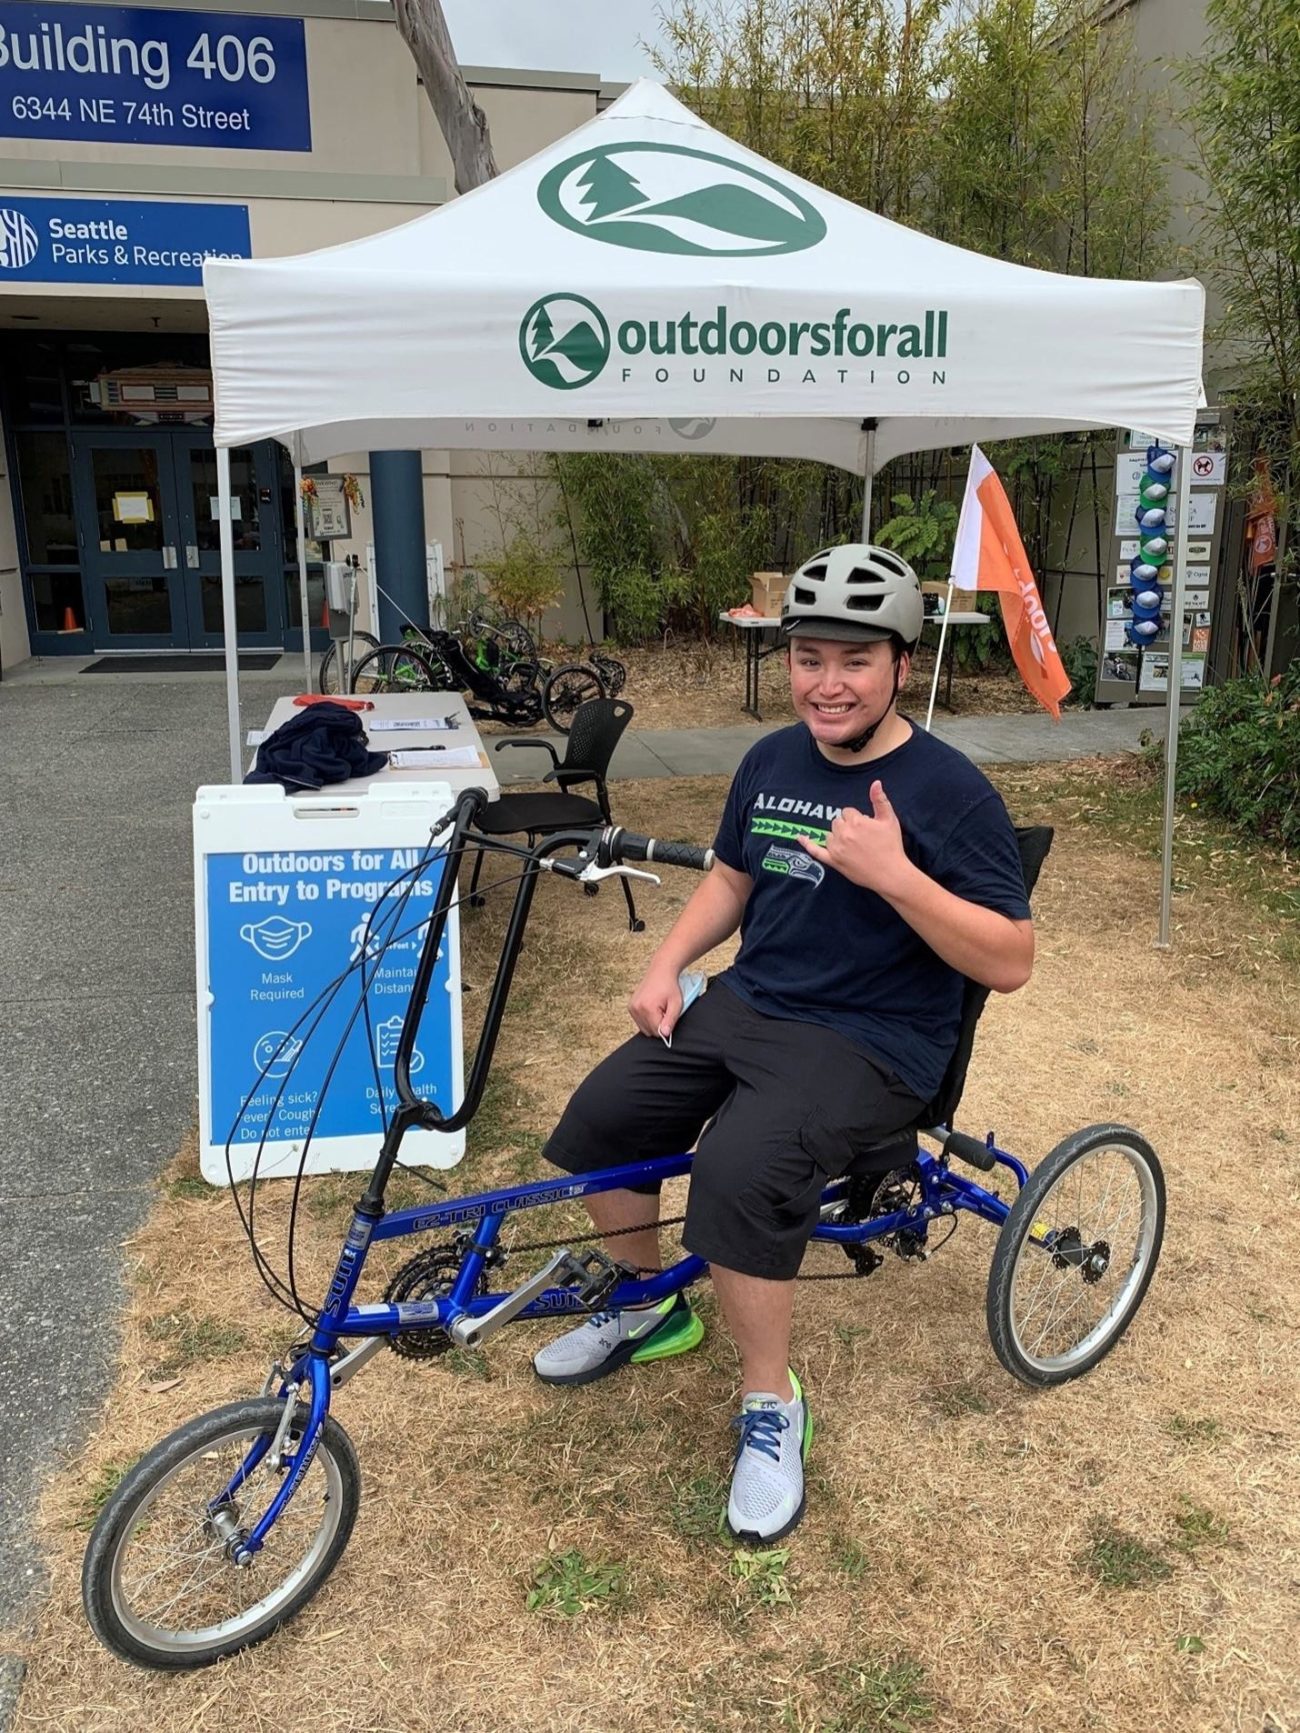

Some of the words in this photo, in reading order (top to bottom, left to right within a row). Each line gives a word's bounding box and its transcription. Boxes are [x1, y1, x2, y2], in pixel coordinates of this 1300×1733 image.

[186, 32, 277, 84] 406
[12, 95, 72, 121] 6344
[79, 98, 116, 124] NE
[122, 101, 174, 127] 74th
[182, 103, 251, 131] Street
[48, 218, 128, 241] Seattle
[52, 244, 109, 266] Parks
[114, 246, 129, 266] &
[617, 305, 948, 358] outdoorsforall
[622, 368, 946, 385] FOUNDATION
[753, 792, 843, 821] ALOHAW
[242, 852, 345, 875] Outdoors
[351, 850, 384, 872] for
[390, 848, 418, 871] All
[229, 880, 290, 906] Entry
[296, 879, 319, 901] to
[326, 878, 434, 903] Programs
[261, 972, 293, 985] Mask
[375, 983, 414, 995] Distan
[250, 987, 305, 1002] Required
[240, 1094, 285, 1108] Feeling
[287, 1090, 318, 1105] sick?
[365, 1086, 395, 1100] Daily
[240, 1128, 257, 1140] Do
[491, 1186, 571, 1215] CLASSIC
